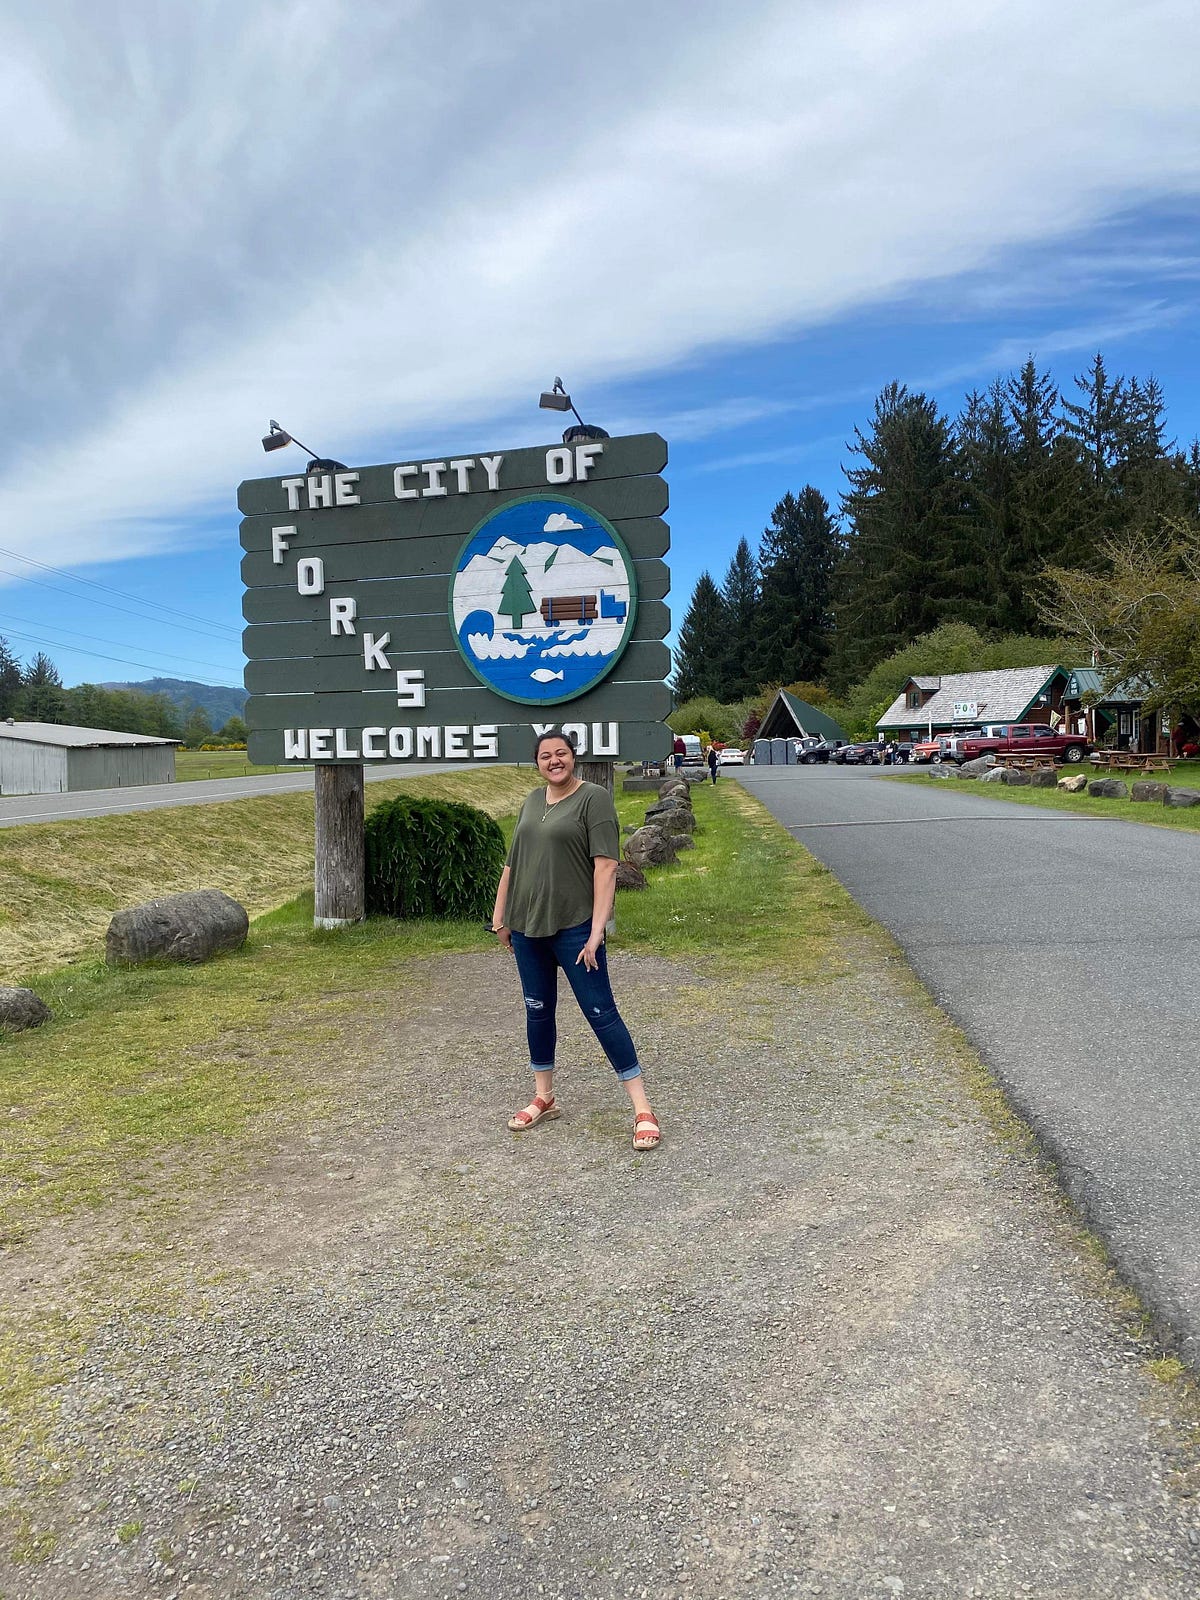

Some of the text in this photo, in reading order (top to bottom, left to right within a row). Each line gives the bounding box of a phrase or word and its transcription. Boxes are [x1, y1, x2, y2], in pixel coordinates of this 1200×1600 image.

[282, 444, 603, 510] THE CITY OF
[271, 525, 425, 708] FORKS
[284, 726, 498, 759] WELCOMES
